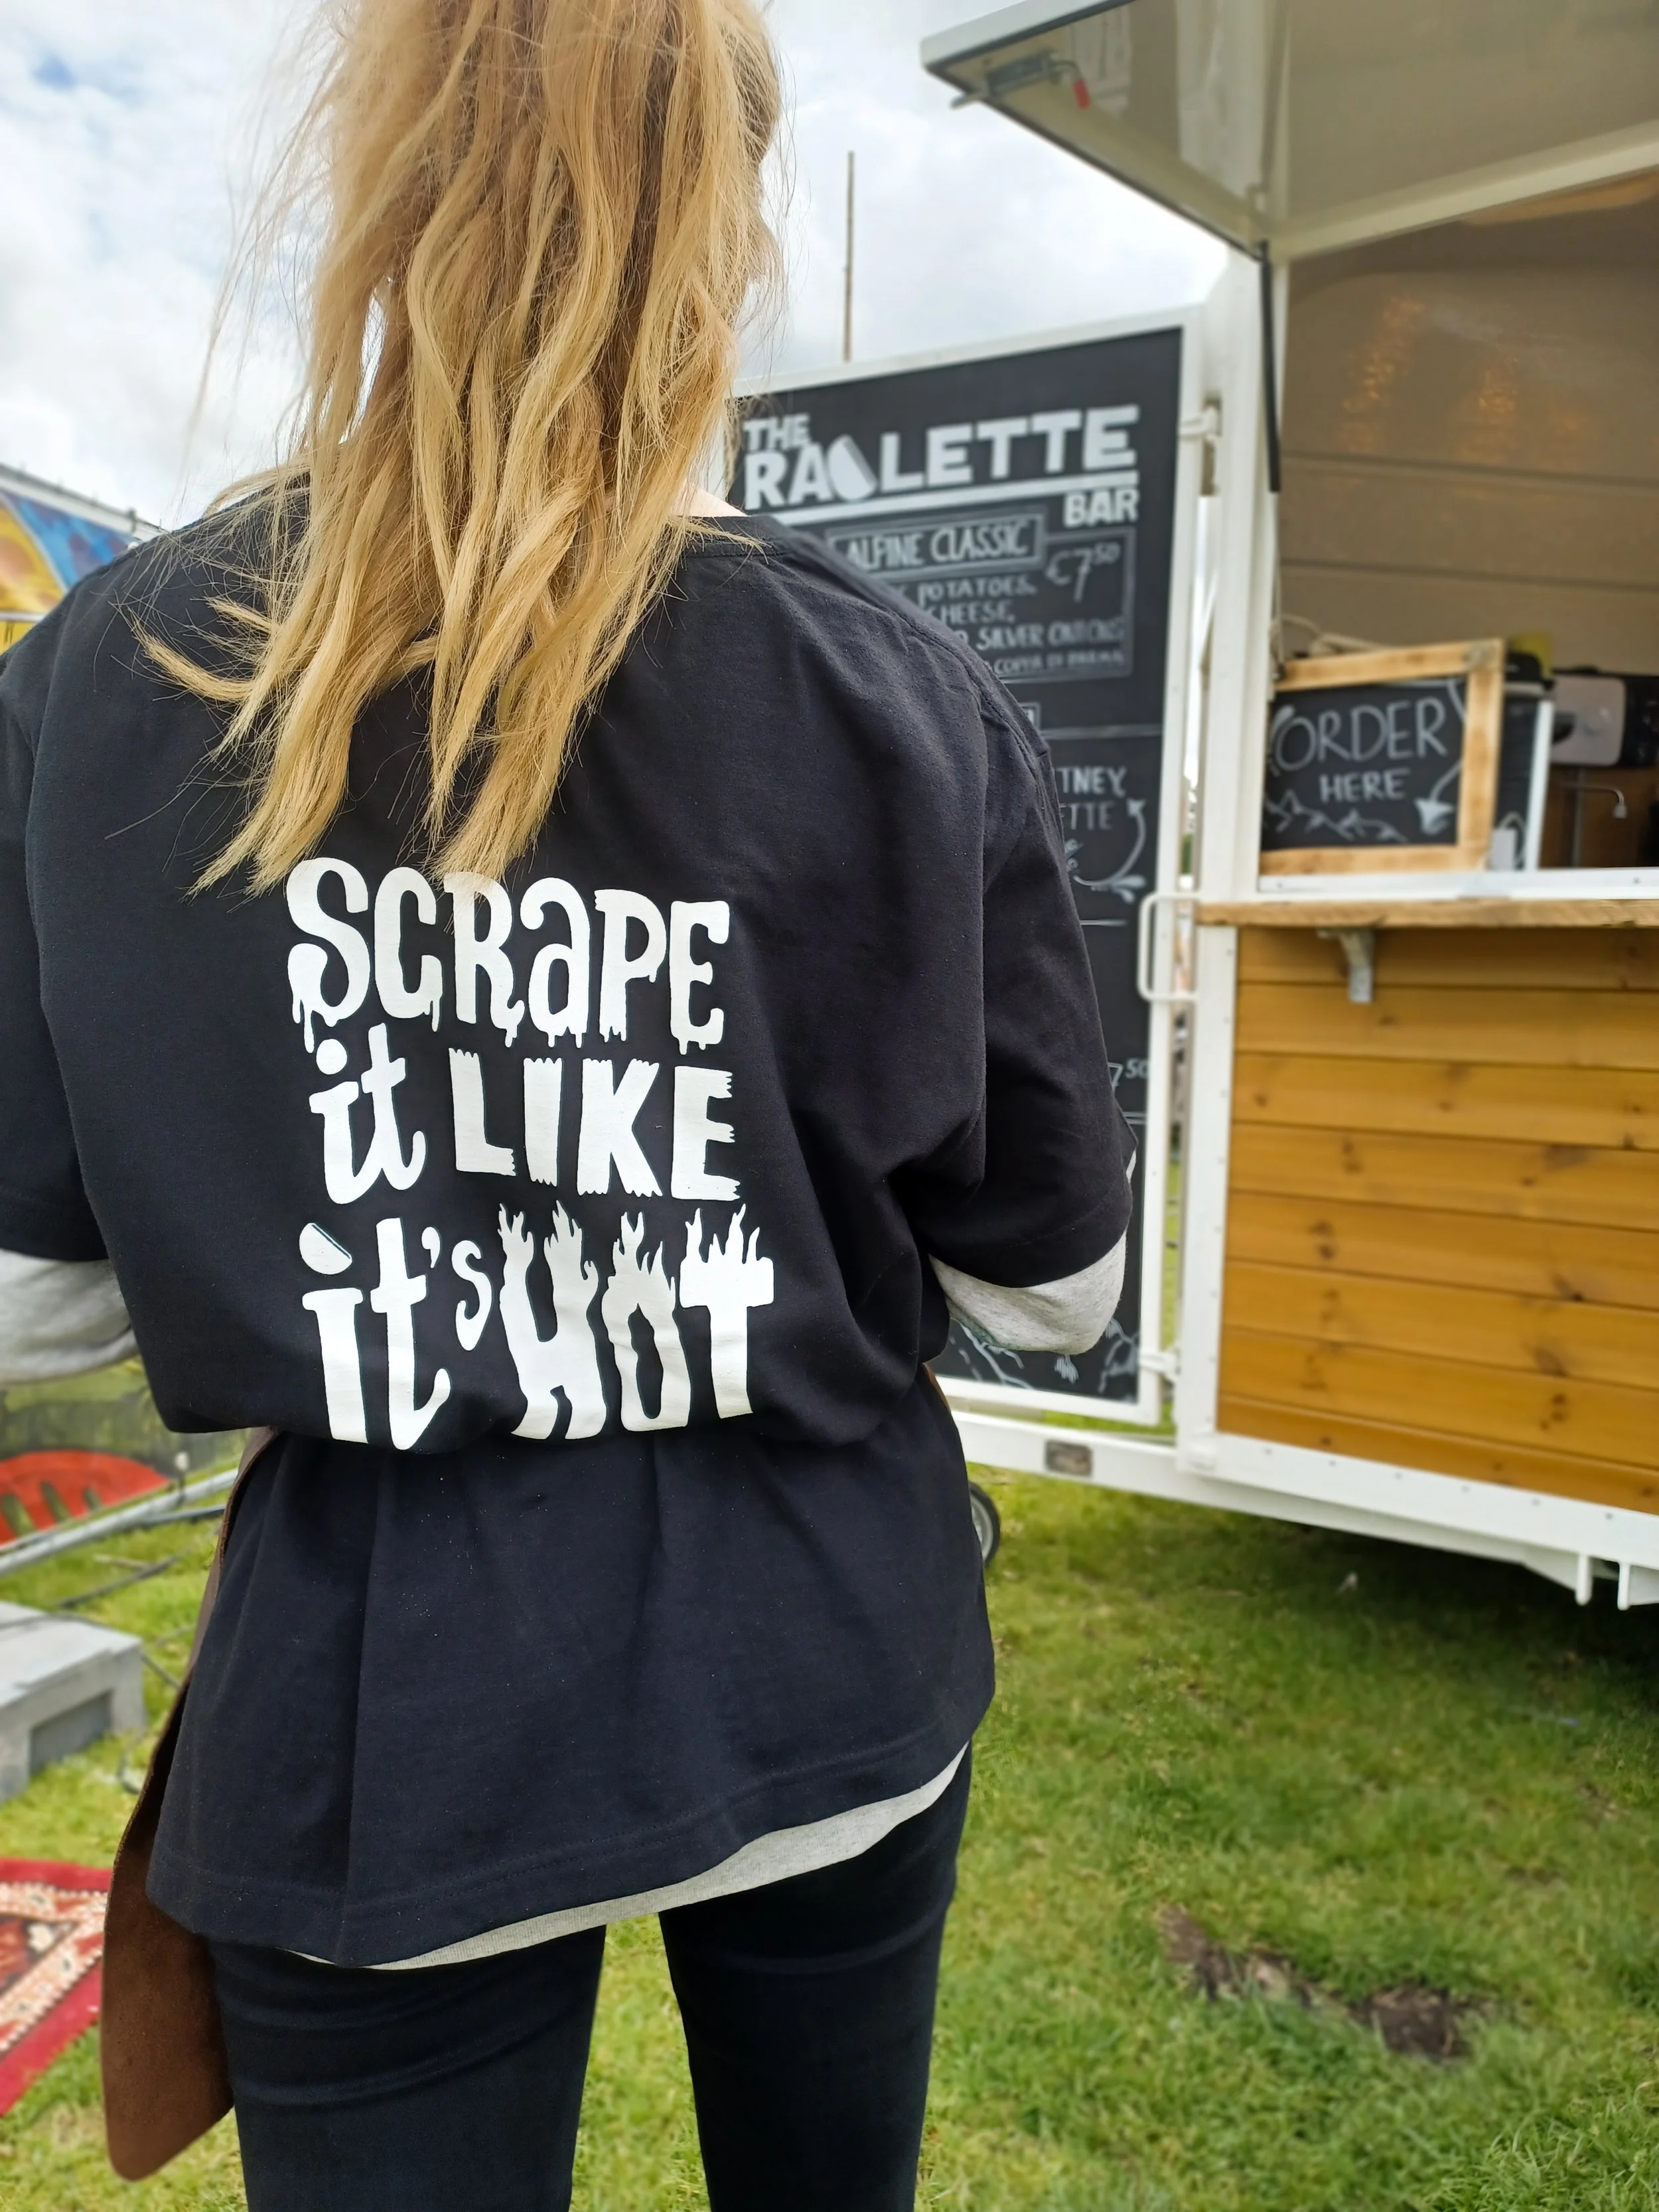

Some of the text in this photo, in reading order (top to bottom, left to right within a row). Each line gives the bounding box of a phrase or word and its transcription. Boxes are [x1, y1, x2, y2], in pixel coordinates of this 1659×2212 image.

[743, 413, 811, 451] THE
[744, 405, 1139, 510] RALETTE
[1063, 487, 1139, 528] BAR
[846, 520, 1028, 570] ALPINE CLASSIC
[975, 623, 1045, 651] SILVER
[1275, 697, 1448, 771] ORDER
[1319, 767, 1411, 804] HERE
[309, 1023, 741, 1205] it LIKE
[497, 1201, 774, 1439] HOT
